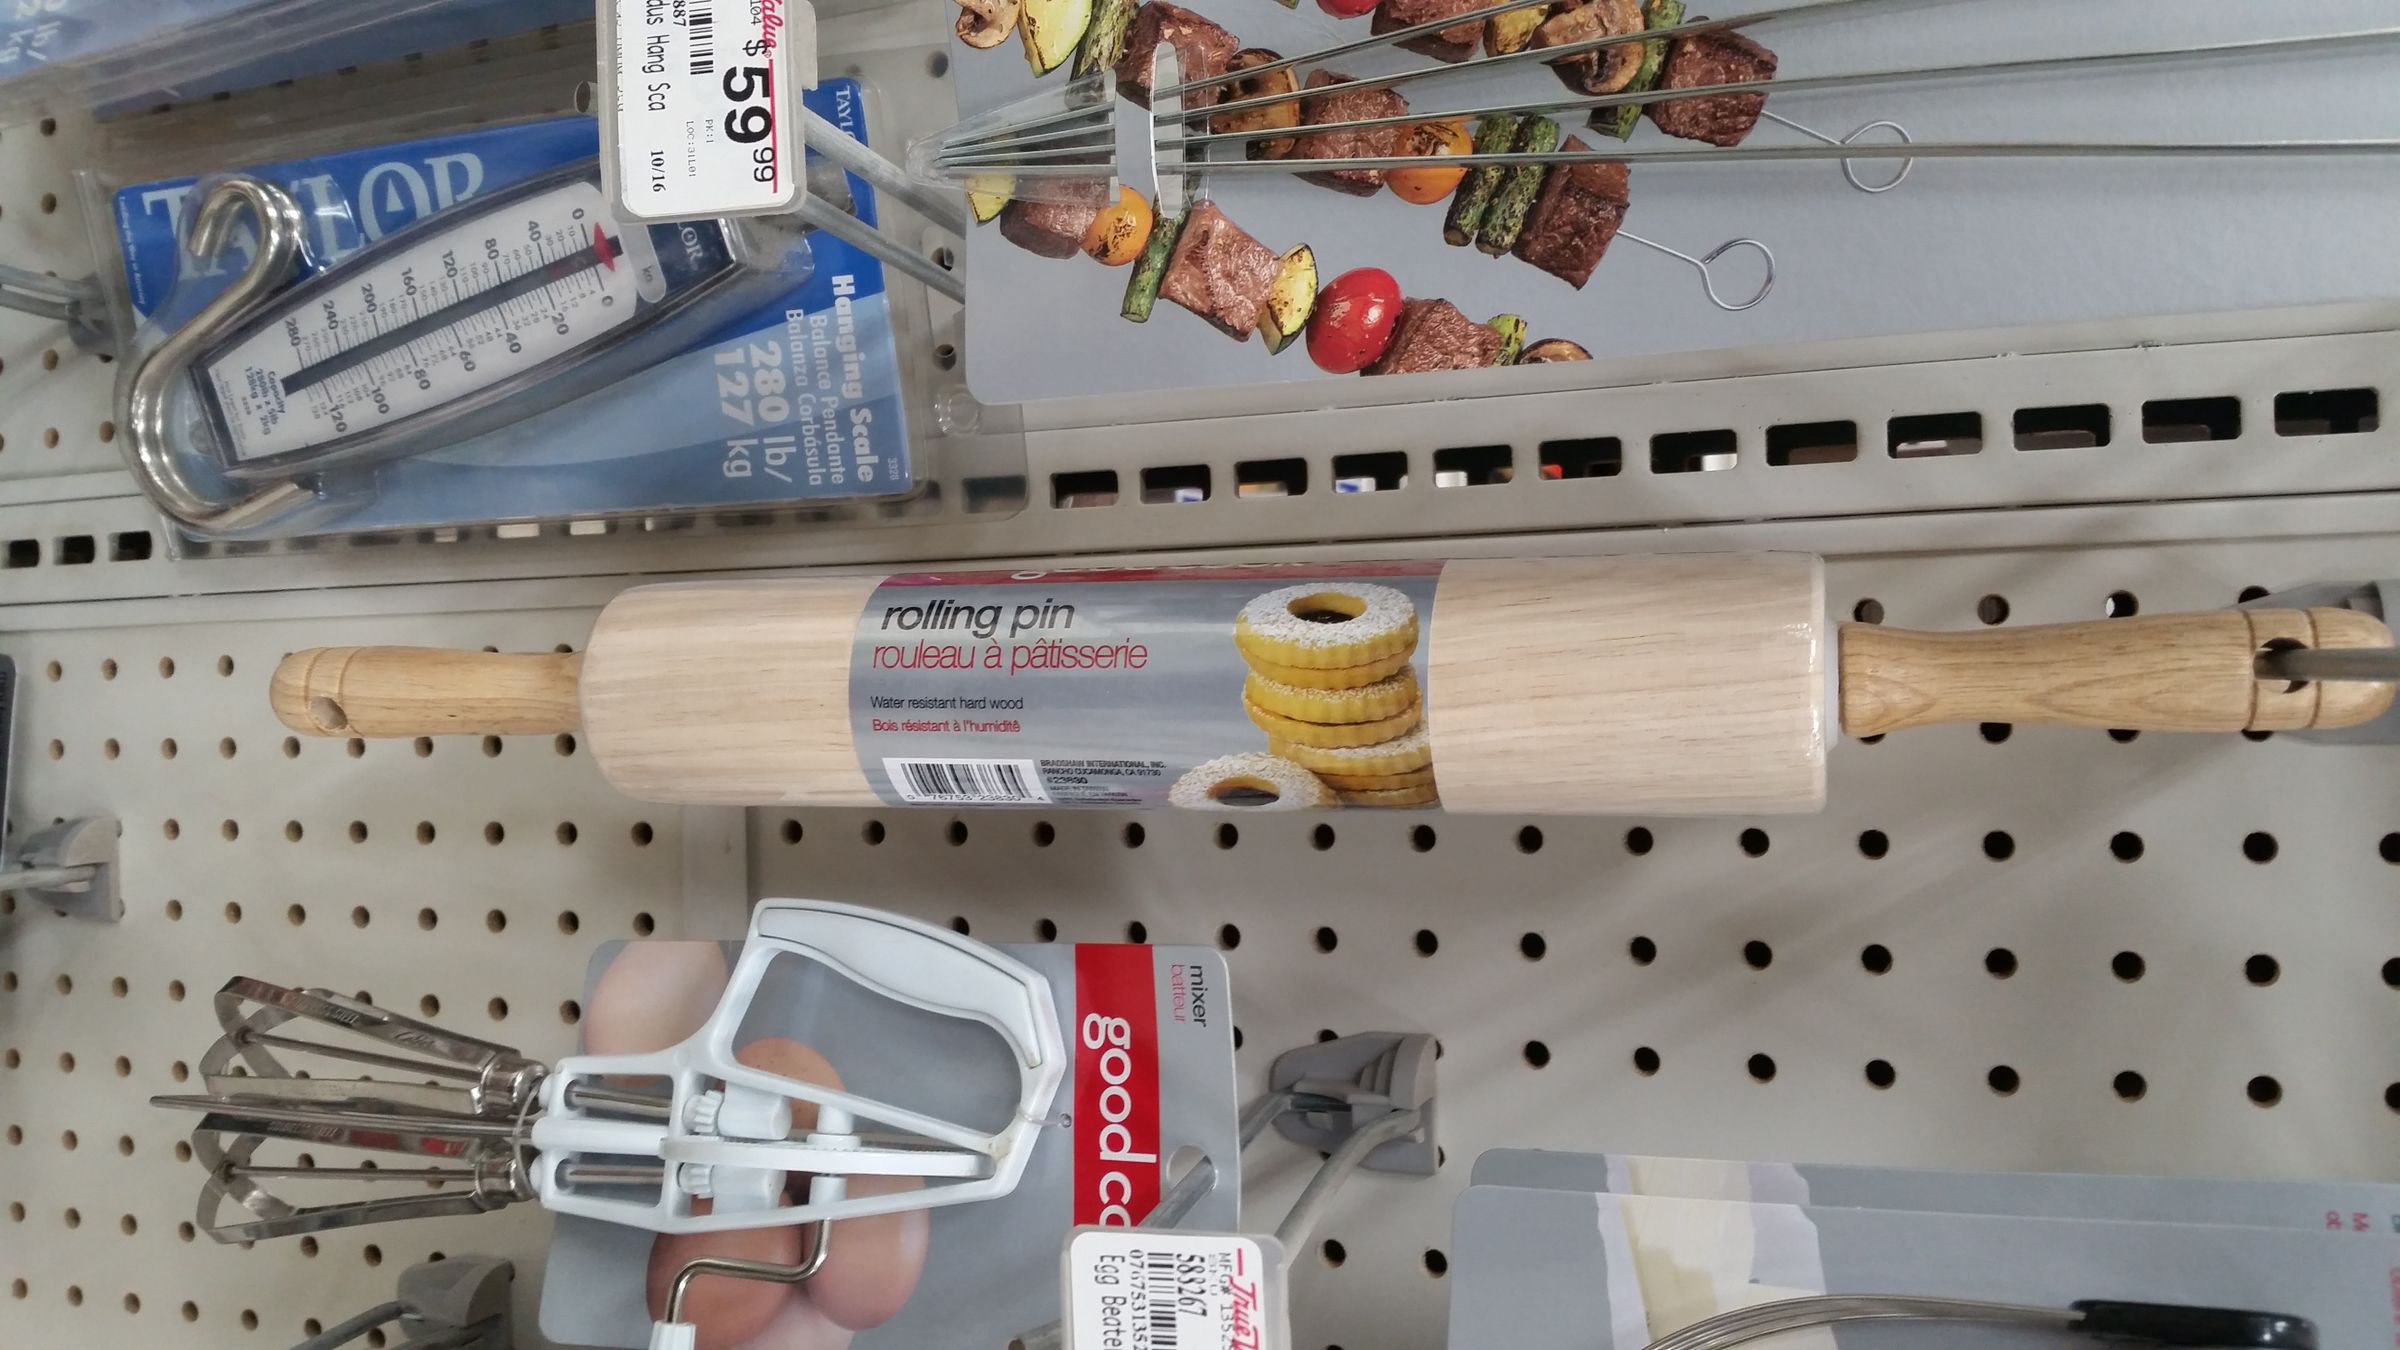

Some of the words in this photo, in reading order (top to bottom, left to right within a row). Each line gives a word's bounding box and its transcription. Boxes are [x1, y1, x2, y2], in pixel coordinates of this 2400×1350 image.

[642, 34, 670, 74] Hang
[647, 82, 671, 112] Sca
[705, 119, 714, 144] PK:1
[650, 149, 667, 193] 10/16
[572, 208, 584, 220] 0
[528, 221, 542, 242] 40
[442, 250, 458, 278] 120
[485, 238, 499, 260] 80
[401, 267, 417, 295] 160
[361, 283, 377, 313] 200
[601, 295, 614, 307] 0
[323, 300, 339, 330] 240
[552, 312, 569, 335] 20
[285, 317, 300, 347] 280
[505, 332, 521, 353] 40
[459, 350, 476, 371] 60
[785, 309, 809, 387] Balanza
[268, 371, 285, 413] Capacity
[414, 369, 431, 390] 80
[714, 347, 755, 427] 127
[750, 340, 790, 423] 280
[831, 274, 866, 399] Hanging
[850, 407, 879, 483] Scale
[372, 386, 390, 414] 100
[809, 314, 832, 390] Balance
[821, 396, 846, 485] Pendante
[330, 404, 347, 433] 120
[722, 438, 759, 478] kg
[763, 435, 797, 484] lb/
[887, 457, 899, 481] 3328
[881, 598, 1002, 639] rolling
[1009, 597, 1075, 638] pin
[873, 638, 975, 669] rouleau
[984, 638, 1002, 669] à
[1010, 638, 1148, 676] pâtisserie
[871, 696, 905, 708] Water
[908, 697, 957, 709] resistant
[959, 697, 986, 709] hard
[989, 697, 1024, 710] wood
[872, 719, 898, 731] Bois
[901, 719, 950, 732] résistant
[953, 720, 960, 732] à
[1169, 964, 1186, 1024] batteur
[1189, 965, 1208, 1028] mixer
[1082, 1012, 1157, 1164] good
[1094, 1255, 1125, 1285] Egg
[1218, 1252, 1232, 1295] MFG#
[1101, 1295, 1127, 1350] Beate
